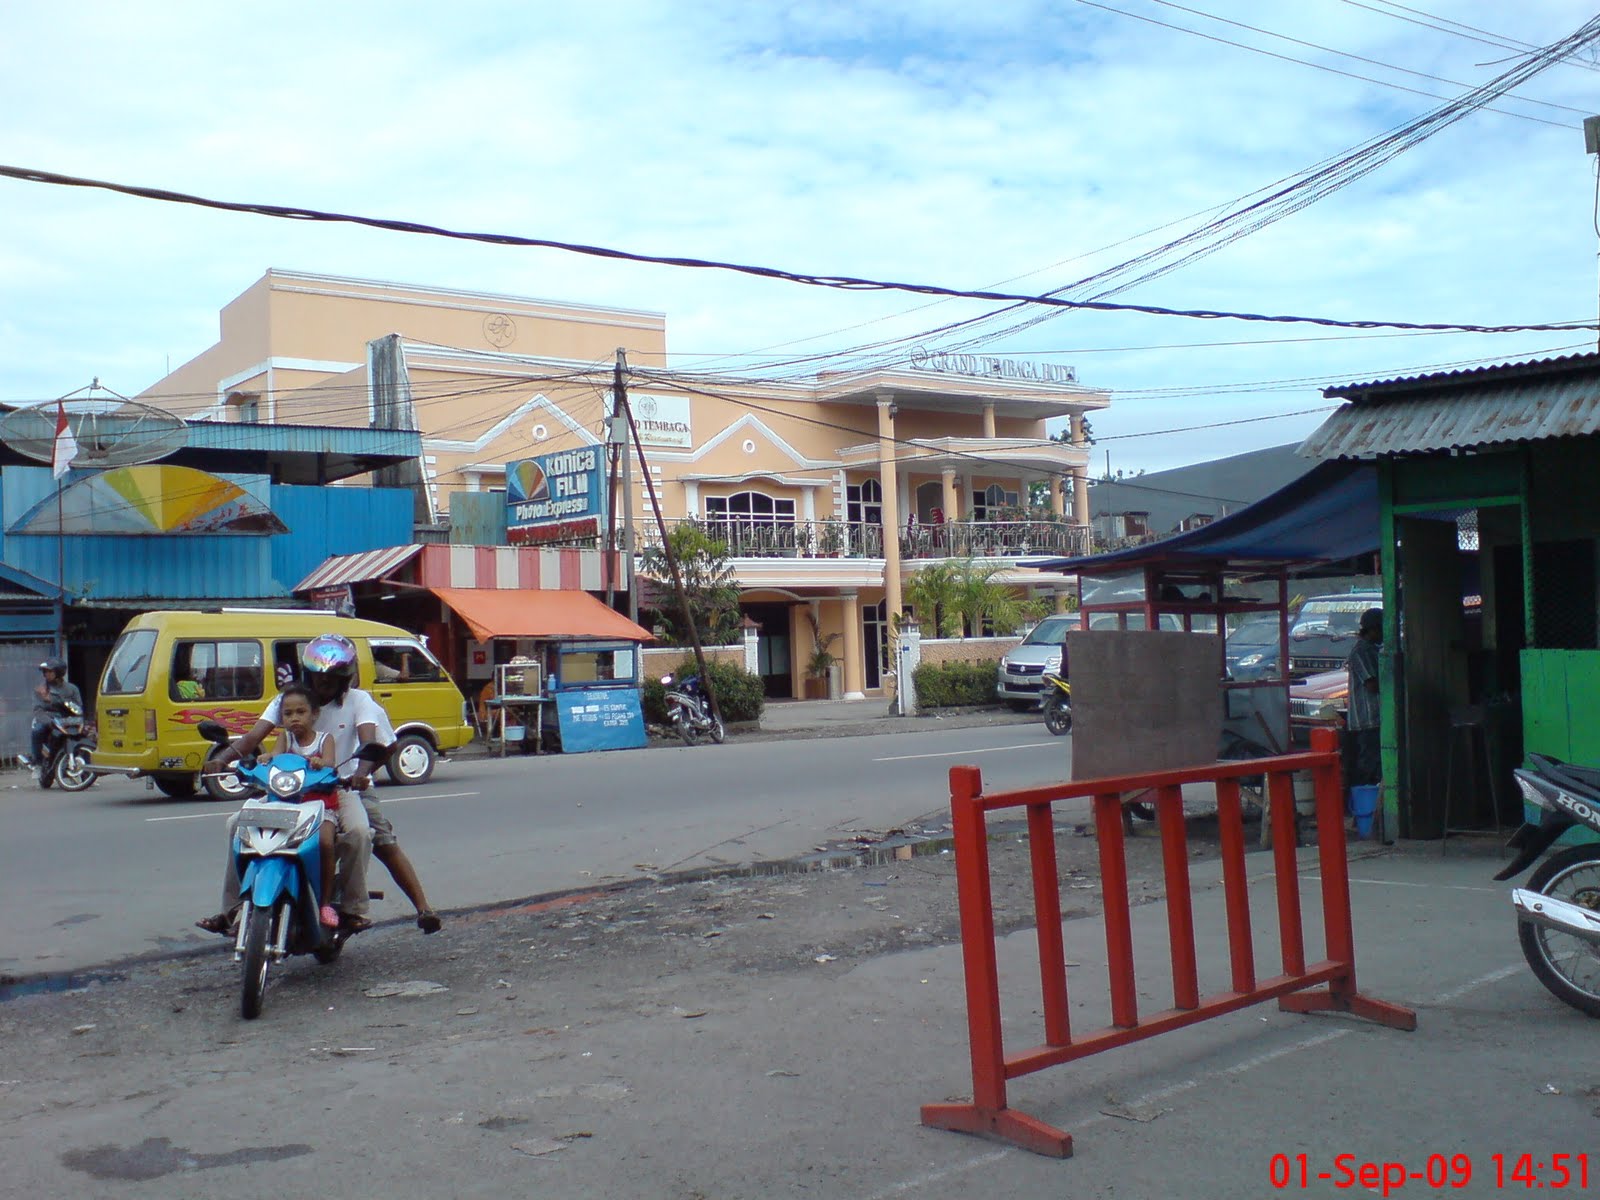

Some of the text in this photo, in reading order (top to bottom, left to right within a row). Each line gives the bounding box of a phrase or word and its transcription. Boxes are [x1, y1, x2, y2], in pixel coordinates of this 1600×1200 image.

[932, 353, 1077, 382] GRAND TEMBAGA HOTEL
[643, 420, 688, 433] TEMBAGA
[545, 449, 596, 477] Konica
[556, 473, 588, 497] FILM
[516, 499, 585, 521] Photo Express
